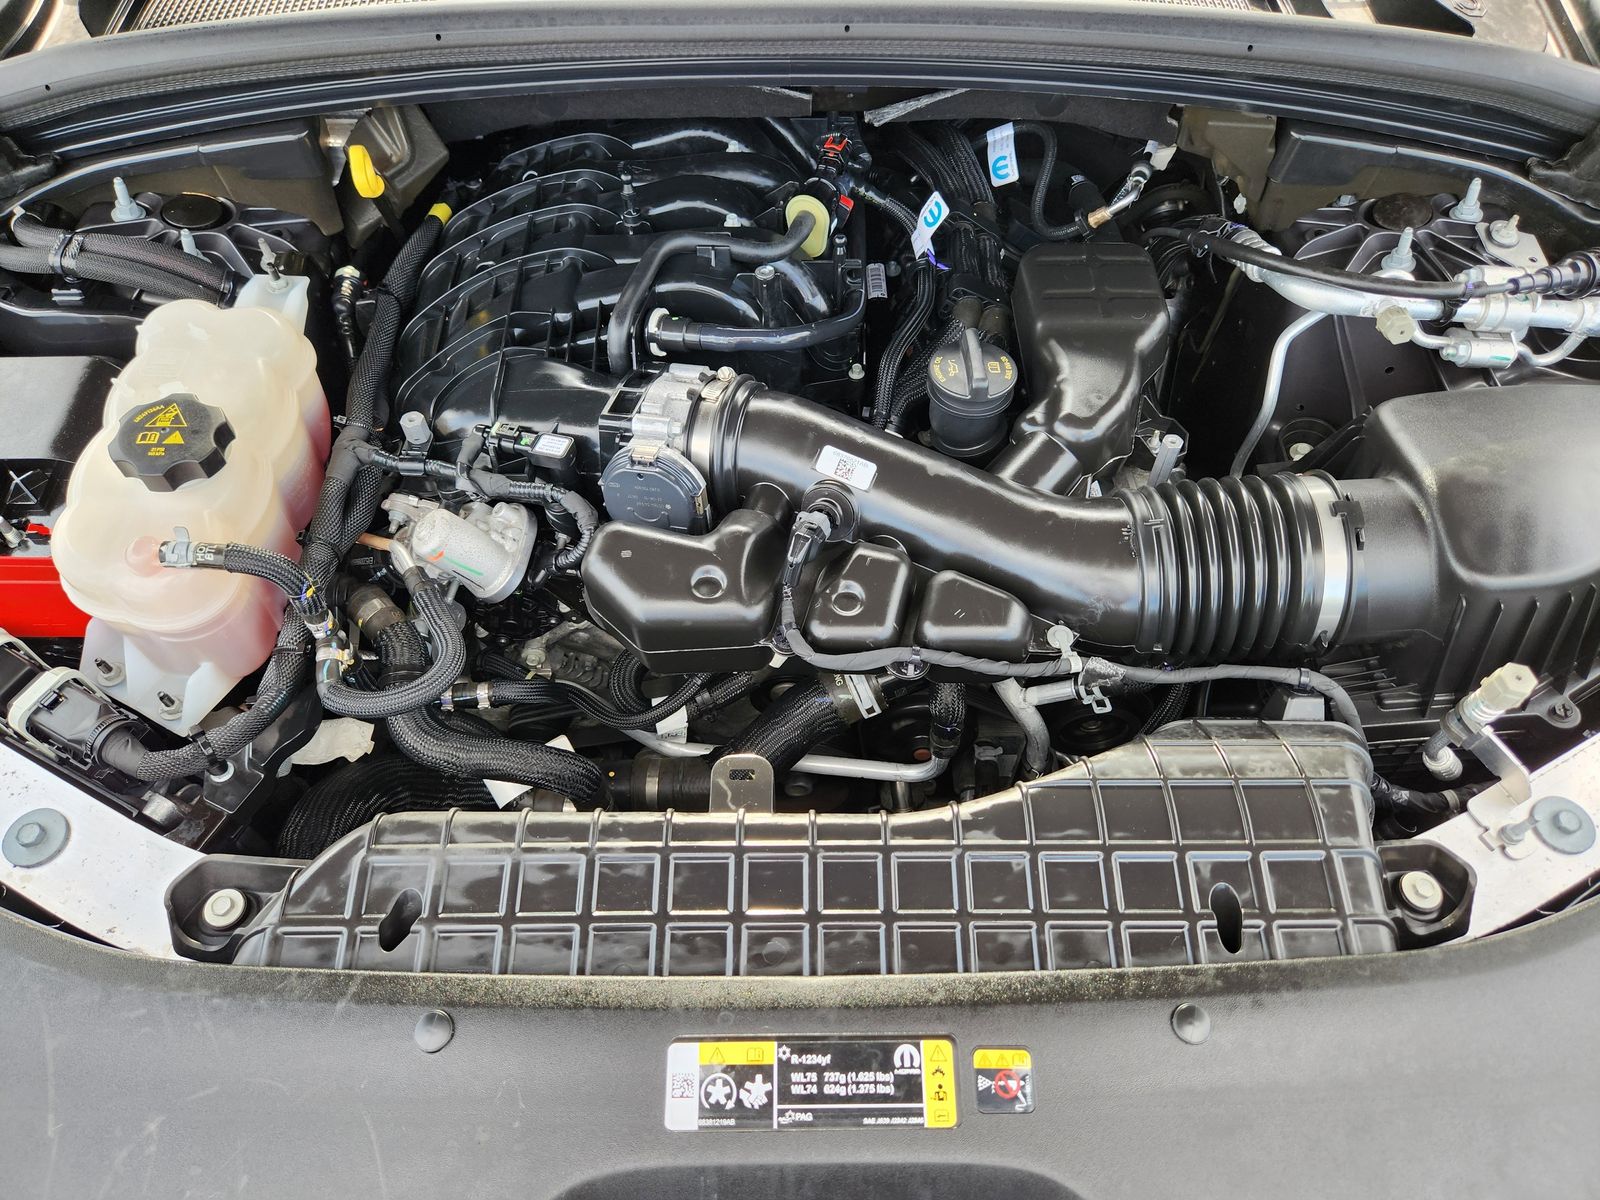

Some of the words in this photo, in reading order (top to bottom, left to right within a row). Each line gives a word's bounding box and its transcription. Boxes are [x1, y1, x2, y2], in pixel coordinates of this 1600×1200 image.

[933, 364, 946, 382] ENGINE
[833, 674, 844, 687] NG
[790, 1053, 831, 1067] R-1234yf
[790, 1072, 818, 1082] WL75
[823, 1072, 846, 1084] 737g
[876, 1072, 894, 1083] lbs)
[790, 1084, 818, 1095] WL74
[823, 1084, 846, 1096] 624g
[847, 1084, 875, 1096] (1.375
[876, 1084, 894, 1096] lbs)
[795, 1112, 814, 1121] PAG
